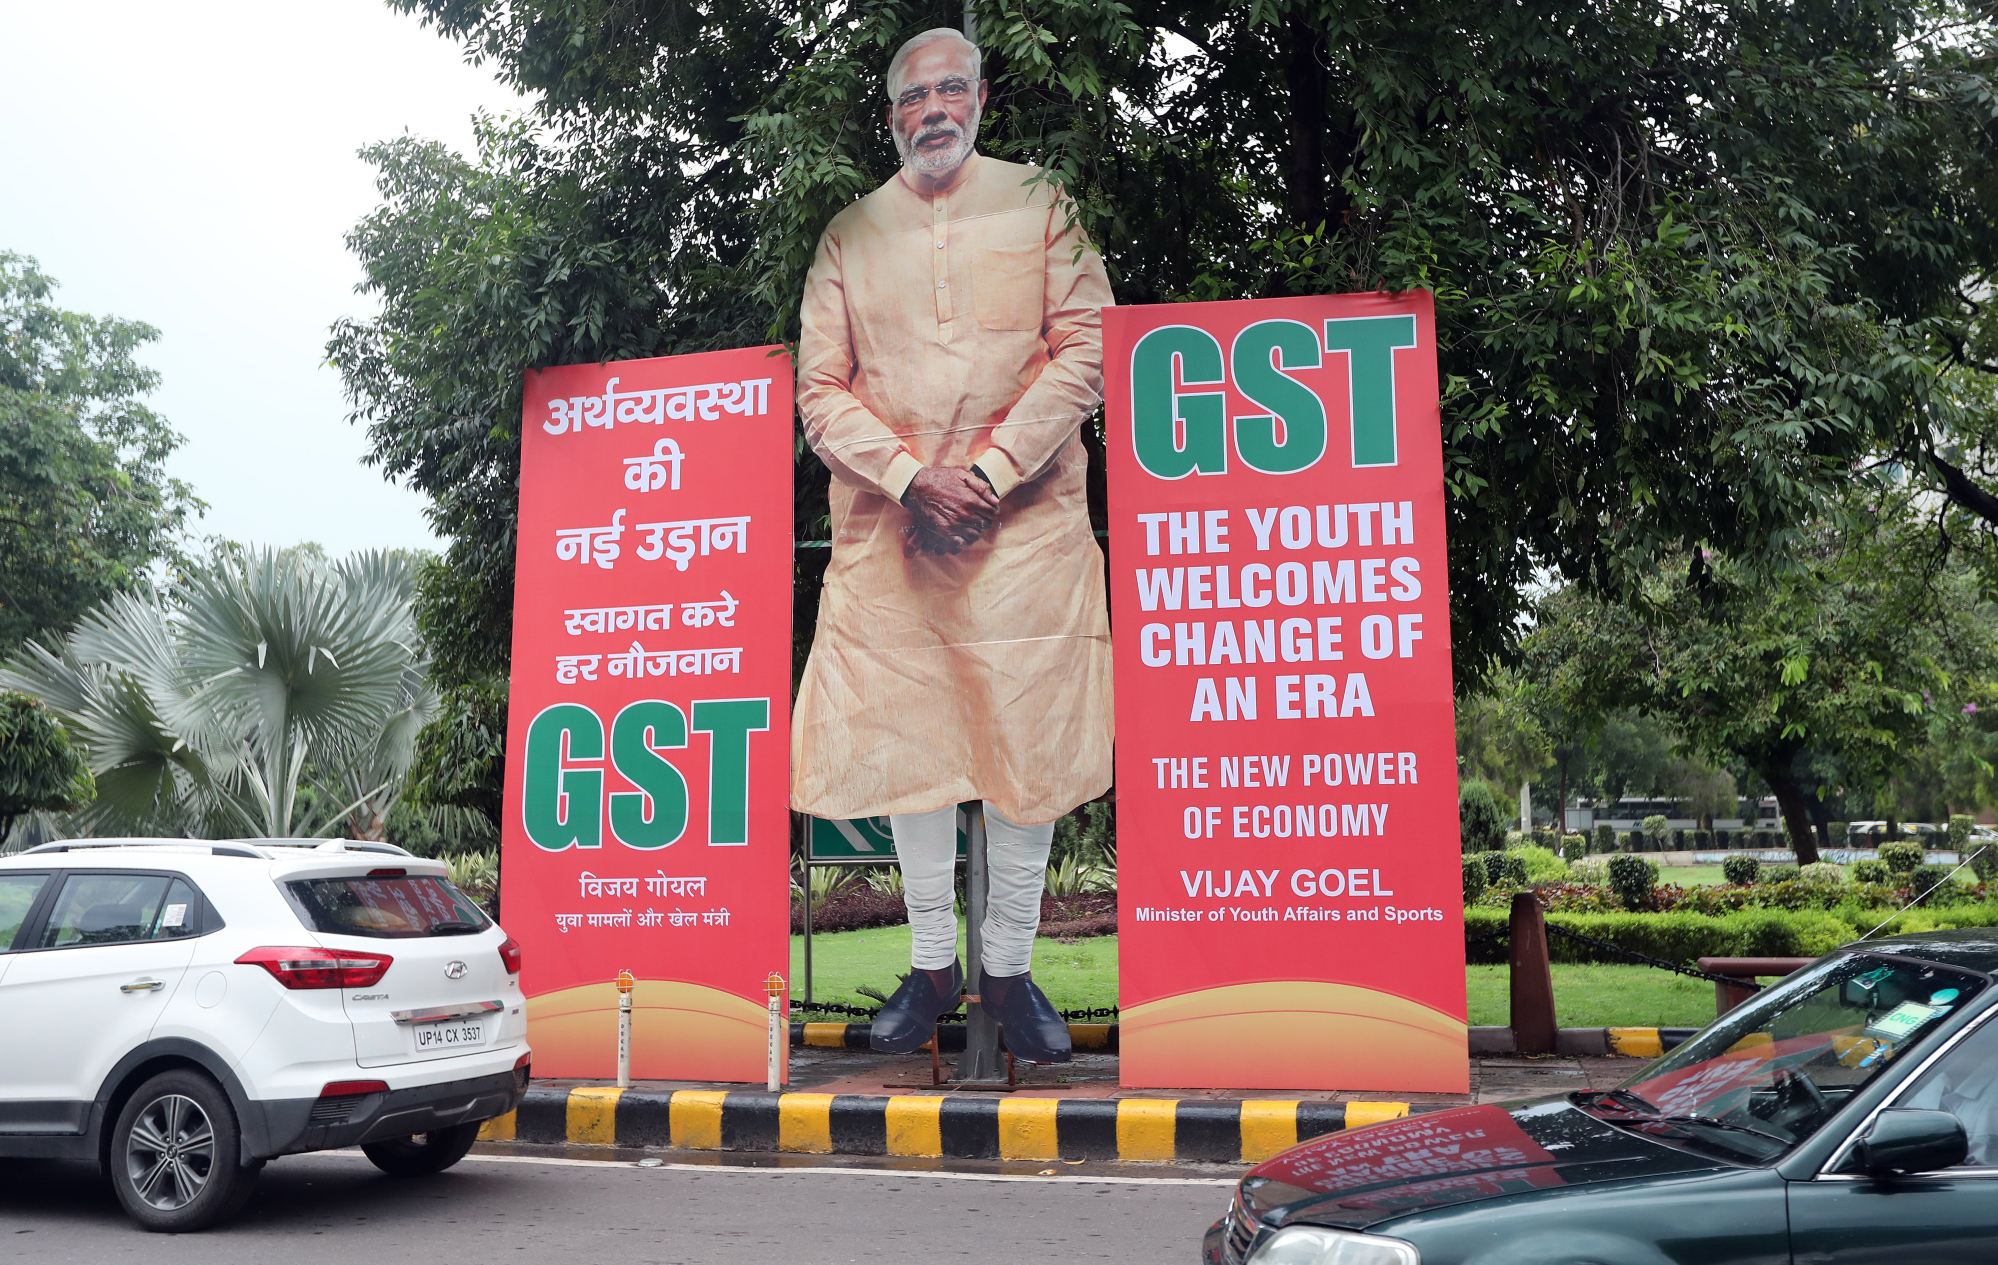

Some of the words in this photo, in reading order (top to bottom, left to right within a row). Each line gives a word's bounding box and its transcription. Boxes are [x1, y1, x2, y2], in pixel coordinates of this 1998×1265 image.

[542, 376, 773, 436] अर्थव्यवस्था
[1129, 313, 1418, 481] GST
[622, 437, 686, 493] की
[555, 507, 627, 570] नई
[635, 515, 752, 572] उड़ान
[1137, 509, 1230, 556] THE
[1244, 500, 1414, 551] YOUTH
[1135, 555, 1422, 612] WELCOMES
[563, 603, 674, 636] स्वागत
[680, 589, 740, 628] करे
[555, 654, 603, 685] हर
[607, 640, 744, 679] नौजवान
[1140, 616, 1344, 668] CHANGE
[1360, 613, 1423, 660] OF
[1189, 676, 1258, 722] AN
[1275, 672, 1376, 720] ERA
[521, 696, 771, 853] GST
[1151, 757, 1209, 789] THE
[1220, 754, 1291, 788] NEW
[1302, 751, 1418, 787] POWER
[1183, 806, 1222, 839] OF
[1232, 803, 1389, 839] ECONOMY
[577, 870, 640, 898] विजय
[644, 869, 708, 898] गोयल
[1179, 869, 1280, 898] VIJAY
[1290, 868, 1394, 898] GOEL
[554, 913, 584, 934] युवा
[586, 908, 633, 928] मामलों
[636, 907, 665, 927] और
[667, 907, 699, 927] खेल
[701, 907, 731, 927] मंत्री
[1136, 907, 1204, 922] Minister
[1208, 907, 1226, 922] of
[1229, 906, 1279, 922] Youth
[1283, 906, 1341, 921] Affairs
[1346, 906, 1379, 921] and
[1384, 905, 1444, 925] Sports
[418, 1029, 443, 1046] UP14
[445, 1029, 460, 1044] CX
[461, 1026, 481, 1042] 3537
